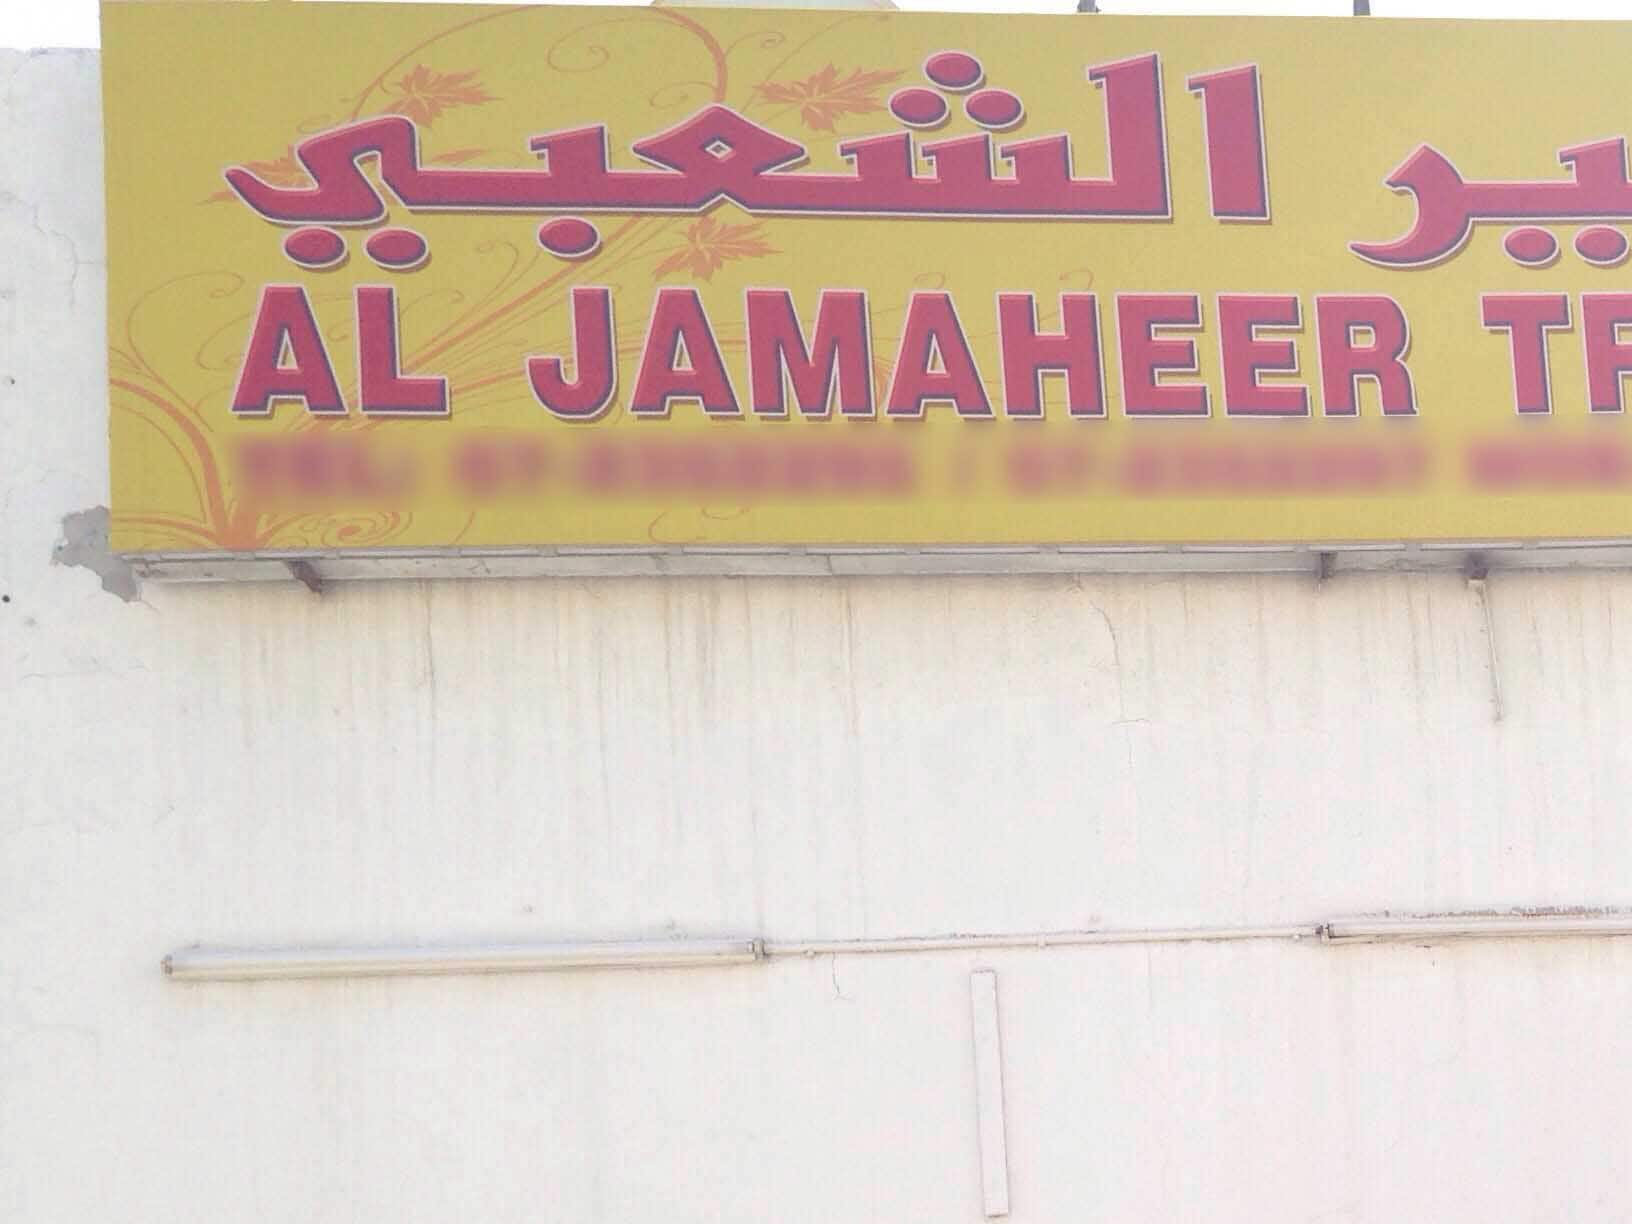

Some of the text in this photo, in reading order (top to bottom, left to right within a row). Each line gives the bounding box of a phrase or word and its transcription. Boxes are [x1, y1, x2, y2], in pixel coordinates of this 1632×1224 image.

[224, 51, 1272, 270] الشعبي
[231, 284, 452, 419] AL
[526, 286, 1419, 422] JAMAHEER
